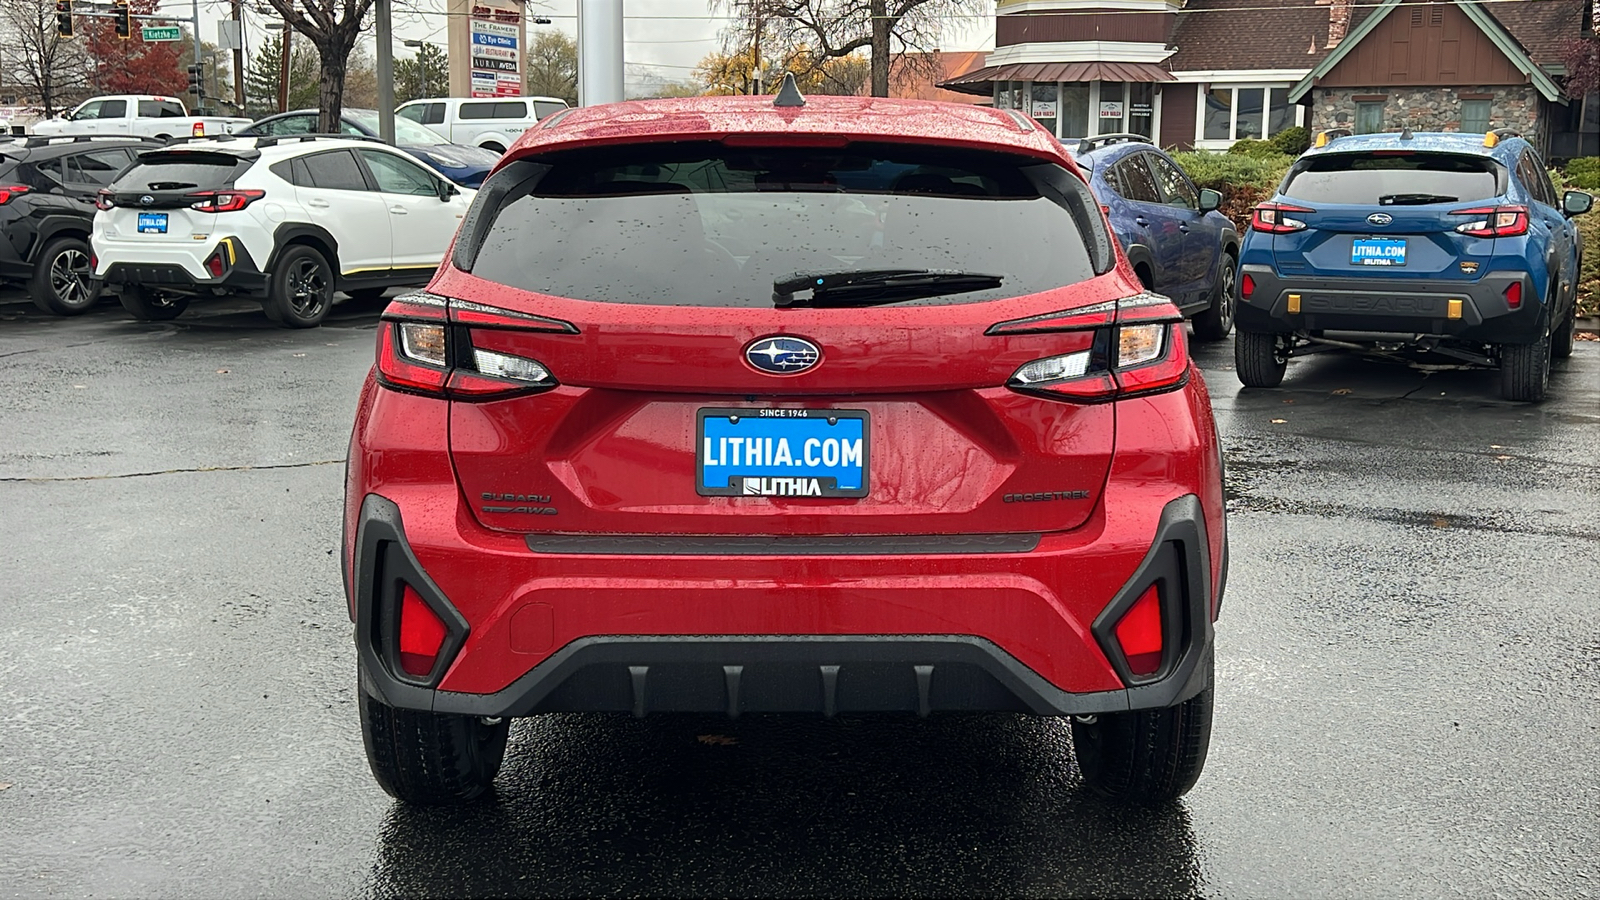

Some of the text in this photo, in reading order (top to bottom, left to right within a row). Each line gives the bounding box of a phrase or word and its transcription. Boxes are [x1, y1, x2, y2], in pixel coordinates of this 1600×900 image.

[474, 21, 487, 29] THE
[489, 24, 516, 33] FRAMERY
[148, 30, 171, 39] Kietzke
[487, 36, 511, 45] Eye Clinic
[485, 48, 509, 57] RESTAURANT
[474, 59, 516, 70] AURA AVEDA
[139, 218, 167, 227] LITHIA.COM
[1352, 245, 1406, 257] LITHIA.COM
[1310, 294, 1438, 313] SUBARU
[759, 409, 786, 417] SINCE
[704, 437, 862, 467] LITHIA.COM
[761, 477, 822, 496] LITHIA
[481, 492, 551, 503] SUBARU
[1003, 489, 1090, 503] CROSSTREK
